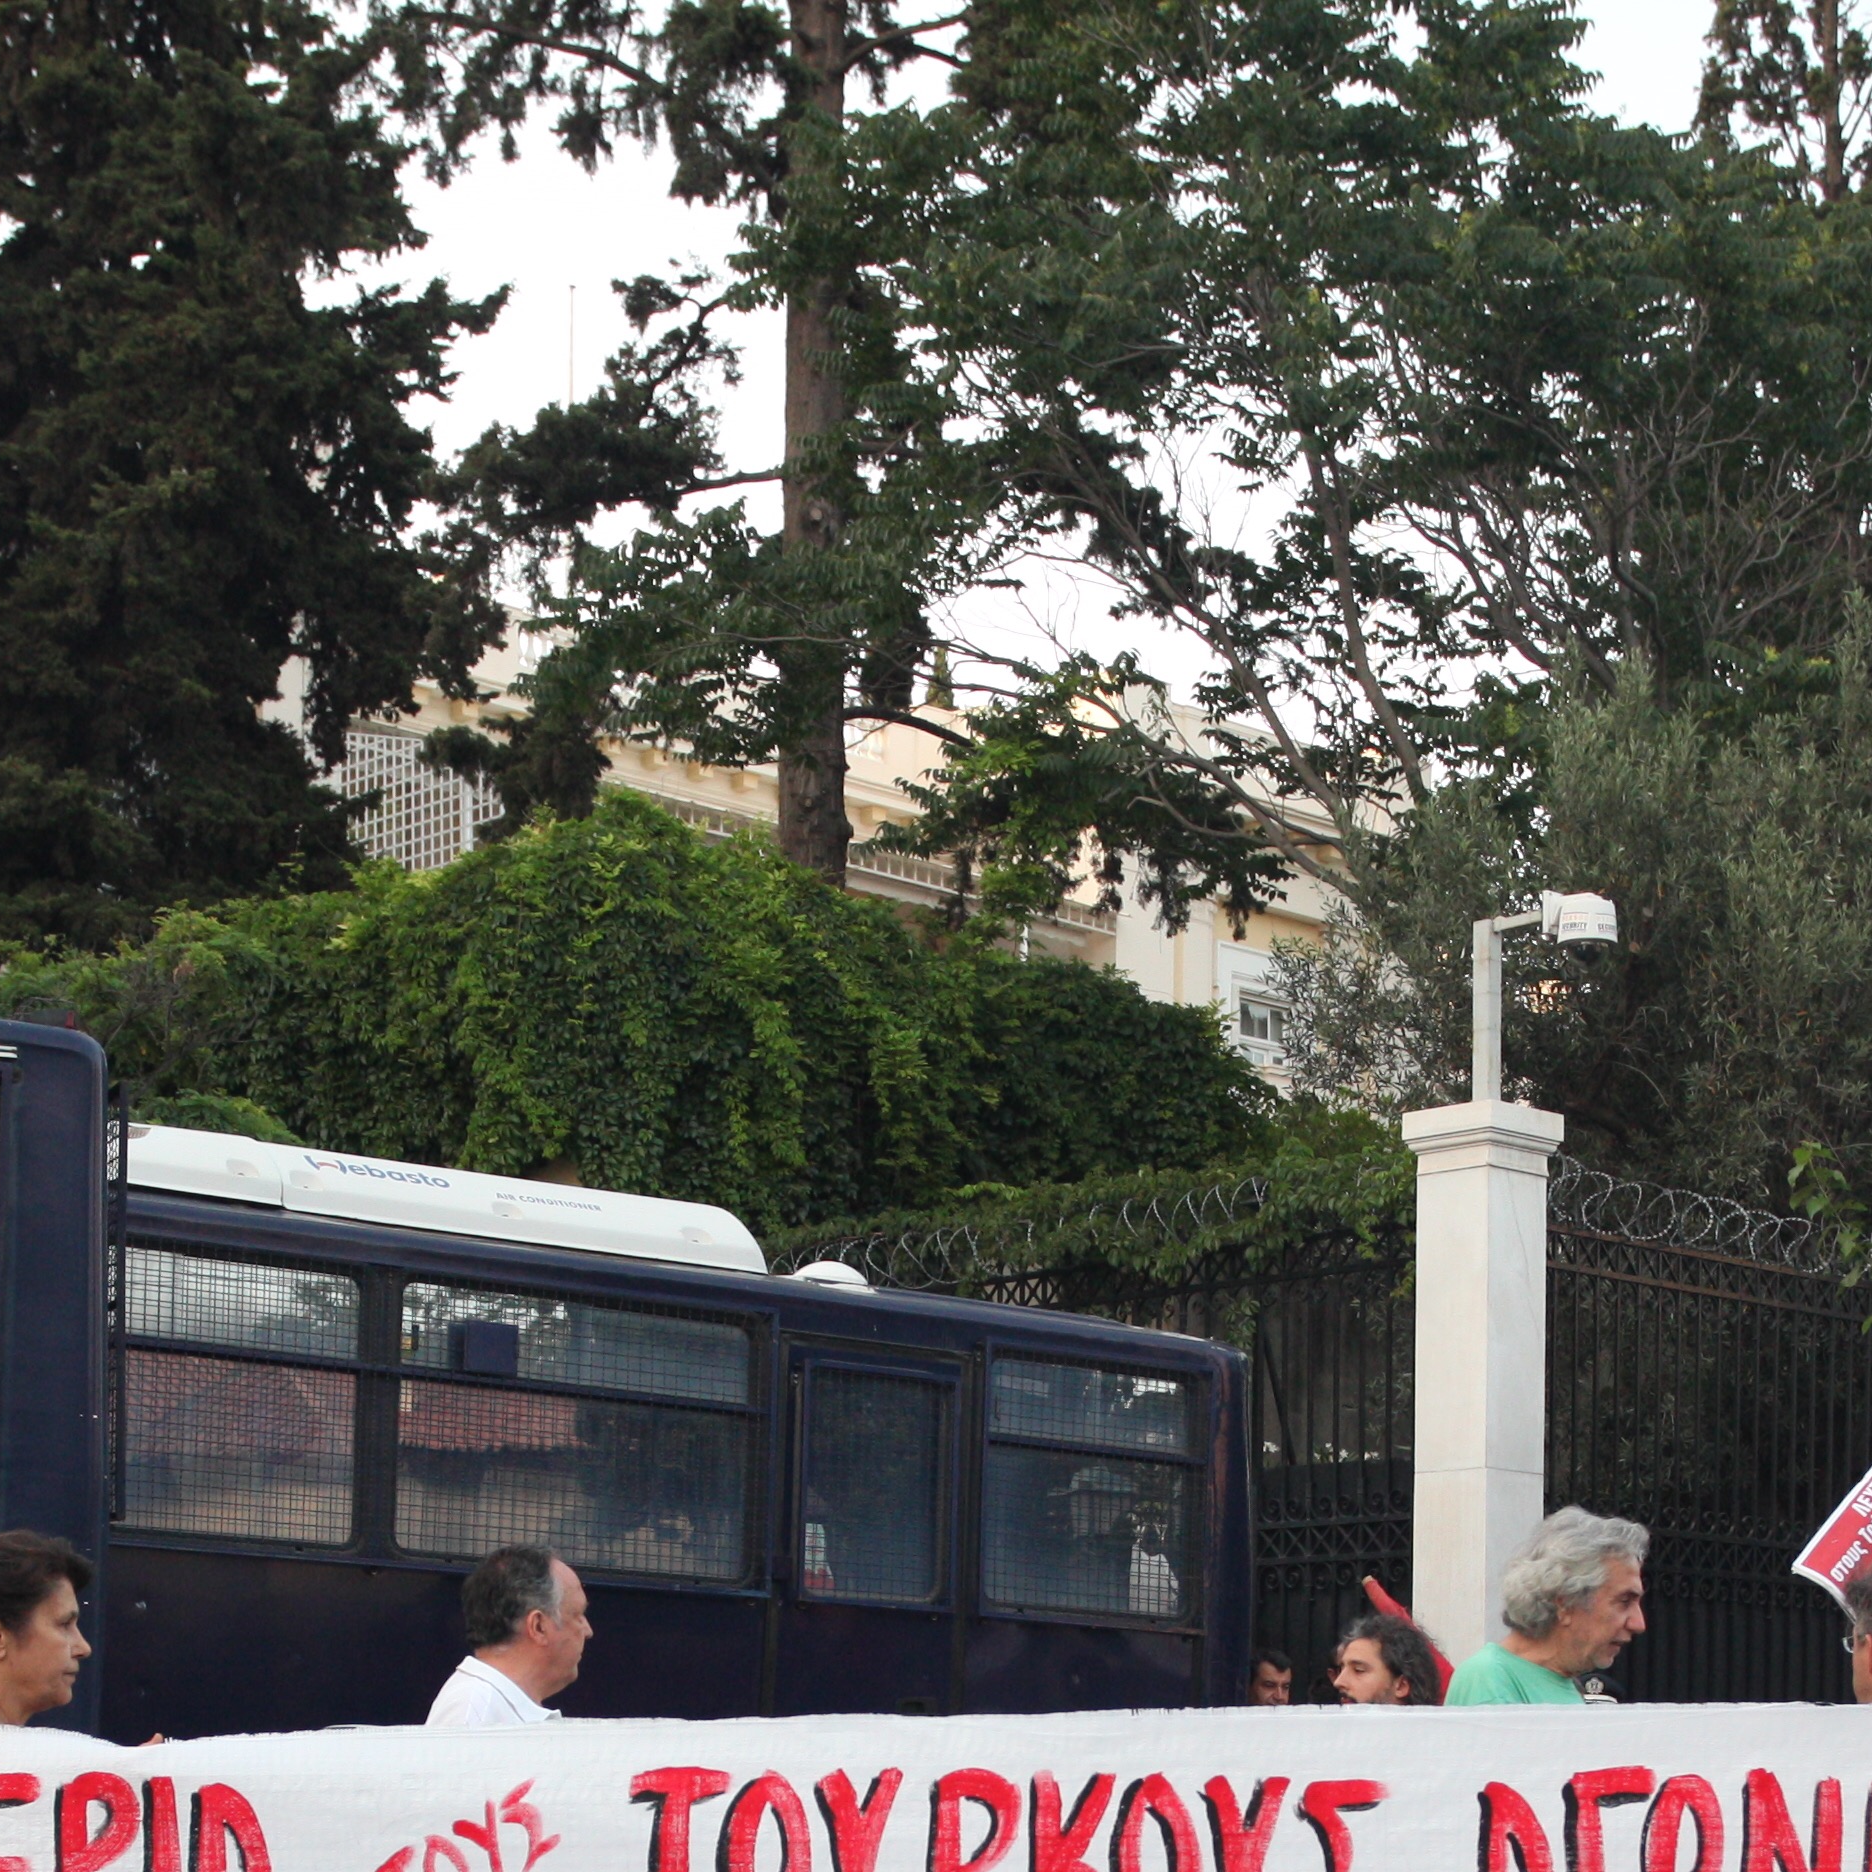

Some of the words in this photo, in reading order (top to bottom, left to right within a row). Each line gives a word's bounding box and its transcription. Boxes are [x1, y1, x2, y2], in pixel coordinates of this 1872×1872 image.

[303, 1154, 451, 1189] Webasto
[495, 1191, 516, 1202] AIR
[518, 1194, 603, 1212] CONDITIONER
[1830, 1539, 1867, 1582] στους
